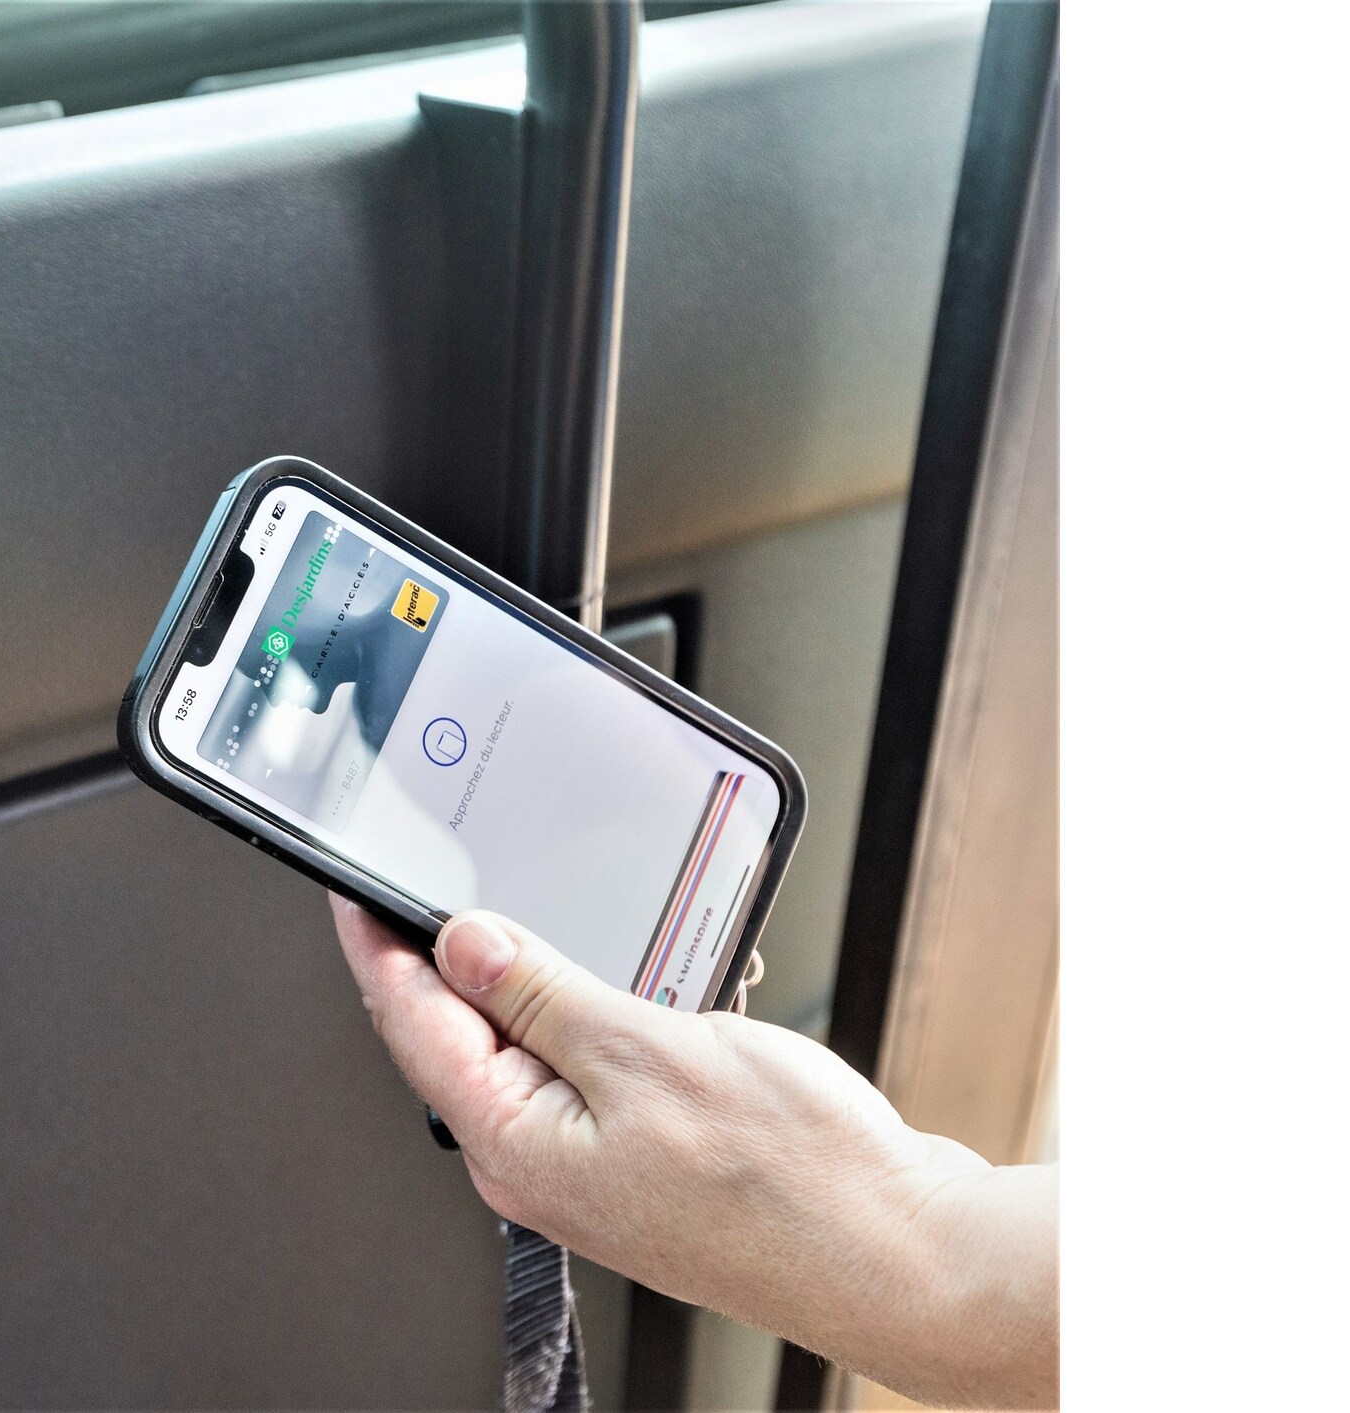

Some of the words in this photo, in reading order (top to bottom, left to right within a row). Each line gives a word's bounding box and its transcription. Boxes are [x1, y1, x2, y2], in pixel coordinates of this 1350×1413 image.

[265, 522, 277, 537] 5G
[282, 540, 334, 628] Desjardins
[403, 584, 420, 624] Interac
[175, 688, 197, 721] 13:58
[486, 700, 515, 745] lecteur.
[480, 746, 493, 764] du
[341, 760, 361, 791] 8487
[449, 763, 486, 832] Approchez
